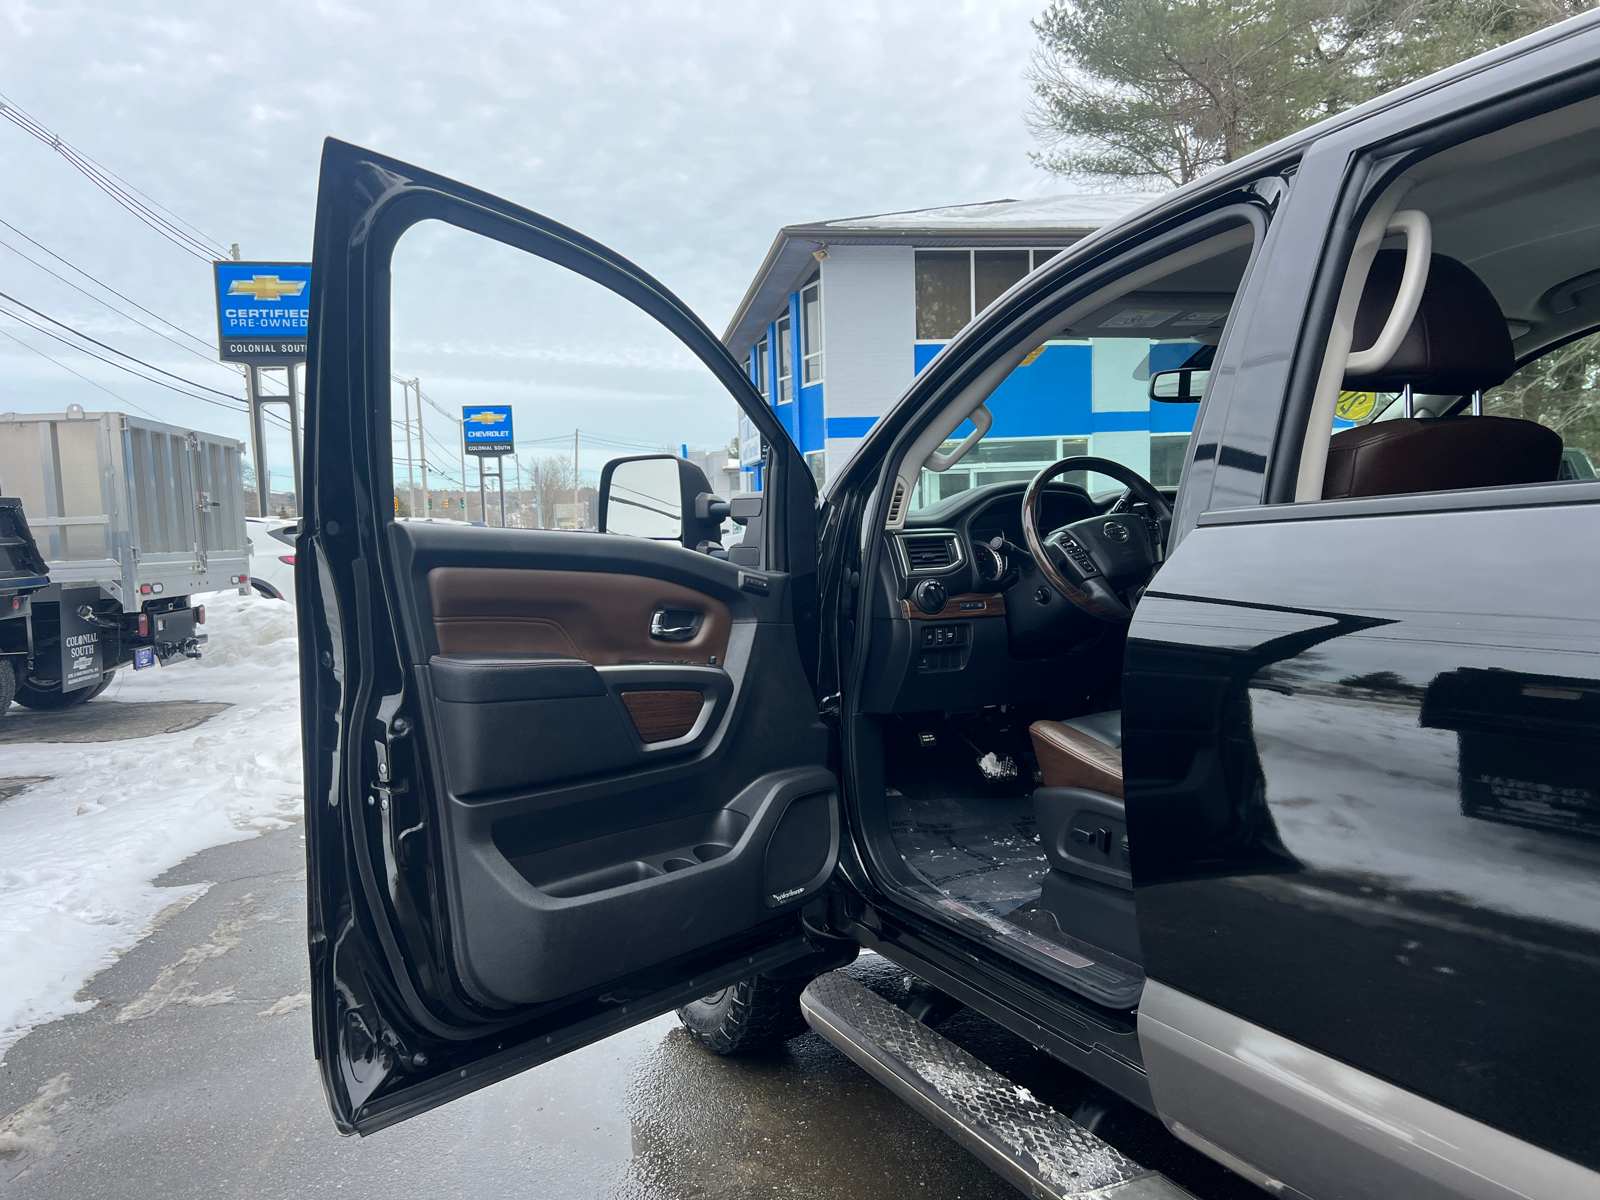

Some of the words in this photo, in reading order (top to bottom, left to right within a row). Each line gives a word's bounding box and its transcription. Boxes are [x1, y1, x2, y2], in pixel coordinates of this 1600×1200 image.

[230, 318, 308, 327] PRE-OWNED
[230, 344, 276, 353] COLONIAL
[281, 344, 307, 353] SOUT
[66, 633, 98, 647] COLONIAL
[71, 645, 94, 658] SOUTH
